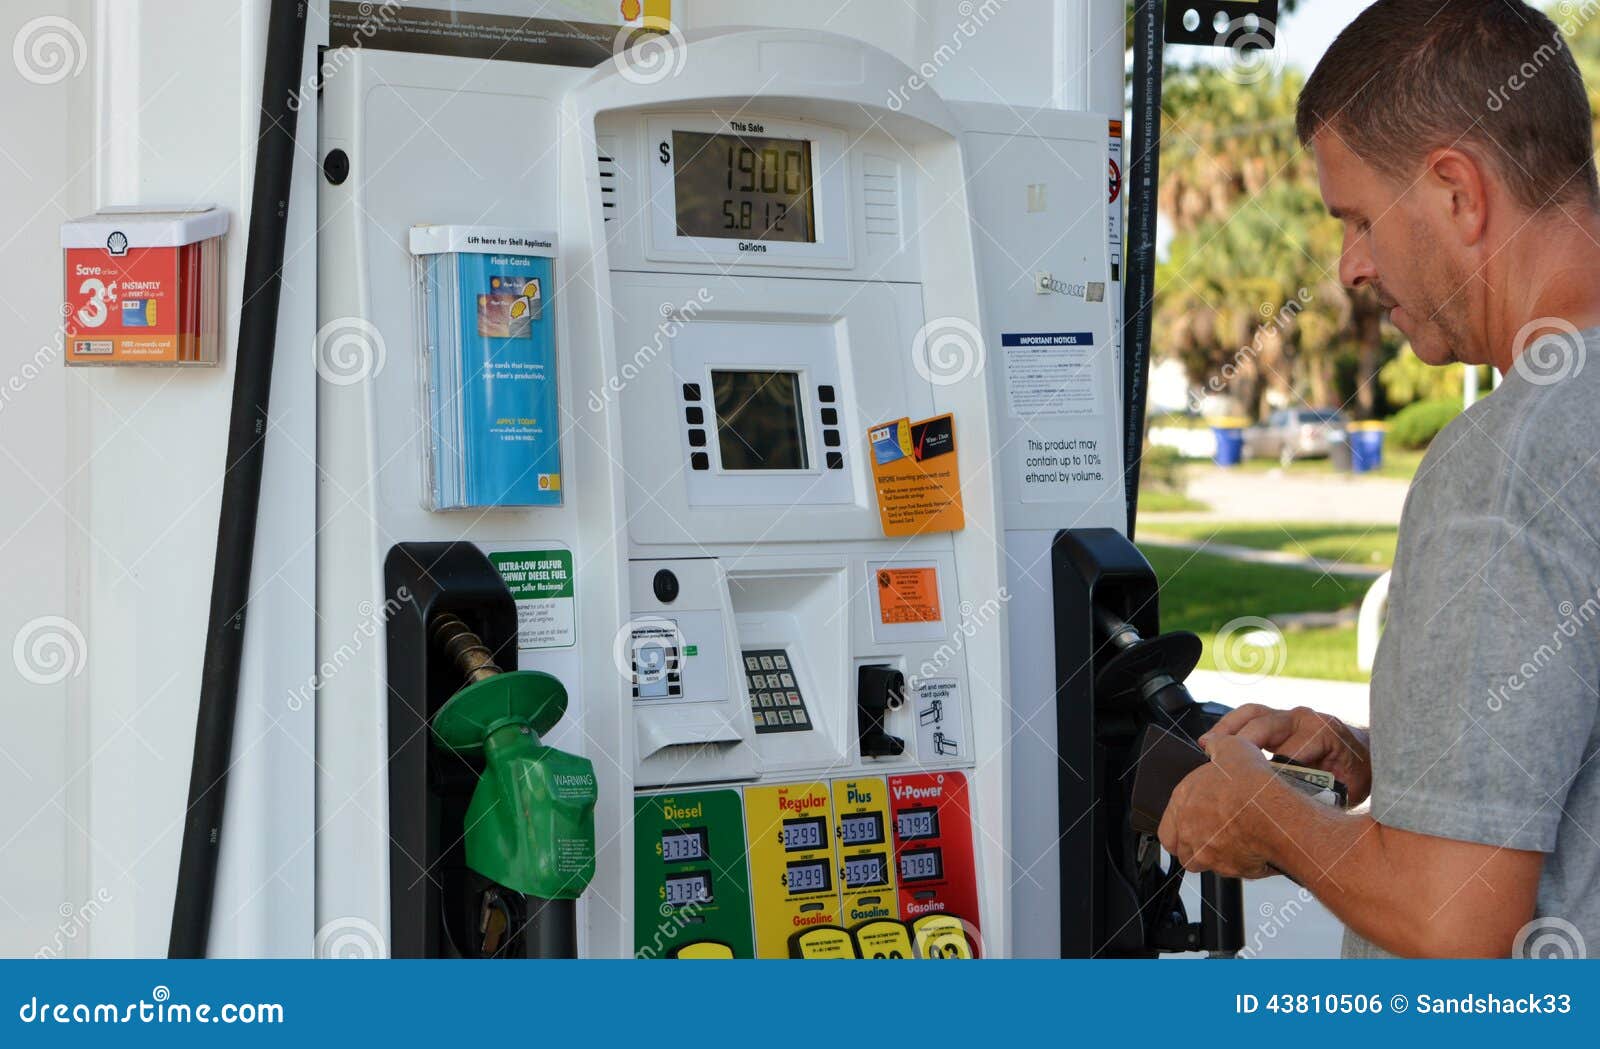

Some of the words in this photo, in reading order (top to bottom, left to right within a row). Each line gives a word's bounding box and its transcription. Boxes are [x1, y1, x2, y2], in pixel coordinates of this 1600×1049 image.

[730, 122, 747, 132] This
[748, 123, 764, 133] Sale
[659, 140, 671, 166] $
[727, 146, 801, 195] 19.00
[468, 236, 480, 244] Lift
[481, 237, 496, 245] here
[498, 237, 508, 245] for
[509, 238, 523, 247] Shell
[524, 239, 552, 248] Application
[738, 242, 767, 253] Gallons
[510, 257, 530, 267] Cards
[76, 263, 101, 276] Save
[122, 281, 161, 290] INSTANTLY
[1020, 336, 1052, 345] IMPORTANT
[1053, 336, 1077, 344] NOTICES
[1028, 439, 1043, 450] This
[1044, 439, 1077, 453] product
[1078, 439, 1097, 451] may
[1026, 456, 1058, 467] contain
[1060, 457, 1071, 469] up
[1072, 456, 1081, 465] to
[1083, 454, 1102, 465] 10%
[1025, 471, 1057, 483] ethanol
[1059, 471, 1069, 484] by
[1071, 471, 1104, 482] volume.
[498, 560, 536, 571] ULTRA-LOW
[538, 559, 562, 569] SULFUR
[528, 571, 550, 581] DIESEL
[551, 570, 567, 579] FUEL
[928, 682, 937, 690] and
[920, 690, 931, 698] card
[932, 689, 950, 699] quickly
[553, 774, 593, 786] WARNING
[847, 789, 872, 803] Plus
[892, 785, 943, 800] V-Power
[778, 794, 827, 812] Regular
[664, 802, 702, 820] Diesel
[851, 906, 889, 919] Gasoline
[907, 901, 945, 914] Gasoline
[793, 912, 833, 926] Gasoline
